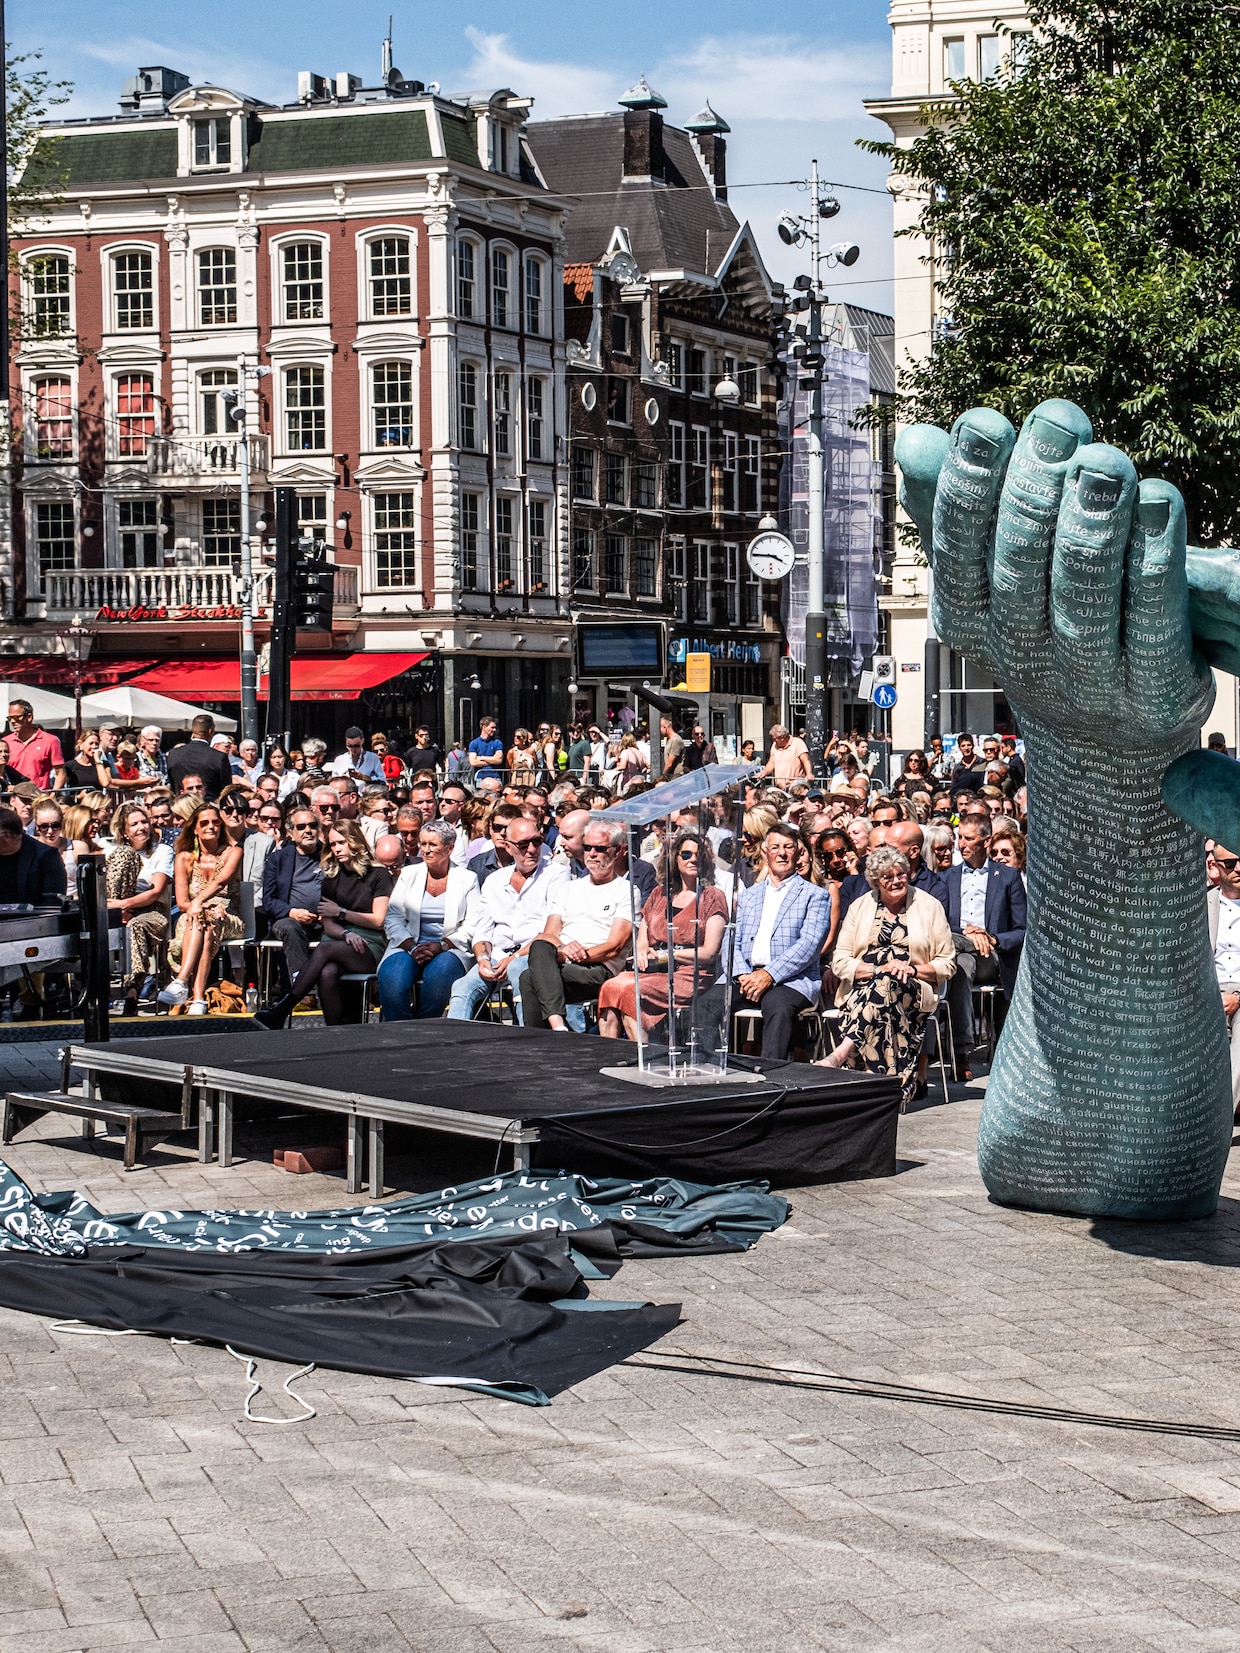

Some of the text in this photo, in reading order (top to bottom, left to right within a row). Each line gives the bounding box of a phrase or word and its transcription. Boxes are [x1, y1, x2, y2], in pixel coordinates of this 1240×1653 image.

[973, 448, 988, 457] za
[1030, 436, 1064, 457] Stojte
[1084, 490, 1117, 502] treba
[1066, 556, 1105, 573] Potom
[172, 604, 266, 620] Steakhoe
[952, 619, 988, 631] Garde
[692, 638, 726, 659] Albert
[1004, 658, 1052, 670] exprime
[1070, 746, 1135, 765] mereka yang
[1048, 756, 1118, 784] ajarkan semua
[1081, 759, 1150, 775] dengan jujur
[1088, 804, 1125, 820] moyoni
[1113, 799, 1164, 813] wanyonge
[1056, 801, 1141, 834] kutetea Na
[1098, 828, 1180, 846] kitakuwa sawa.
[1075, 870, 1185, 893] Gerektiğinde dimdik
[1067, 878, 1162, 908] için ayağa kalkın,
[1059, 887, 1157, 919] söyleyin ve adalet
[1045, 895, 1174, 938] çocuklarınıza da aşılayın.
[1040, 905, 1190, 948] girecektir. Blijf wie je bent...
[1067, 935, 1170, 961] recht, kom voor
[1052, 941, 1154, 974] eerlijk wat vindt
[1054, 969, 1129, 998] allemaal goed.
[1088, 968, 1176, 986] breng dat weer
[1078, 1047, 1165, 1065] mów, myślisz
[1056, 1056, 1153, 1077] przekaż swoim
[1063, 1069, 1097, 1083] fedele
[1086, 1087, 1145, 1103] minoranze,
[1103, 1101, 1153, 1113] giustizia.
